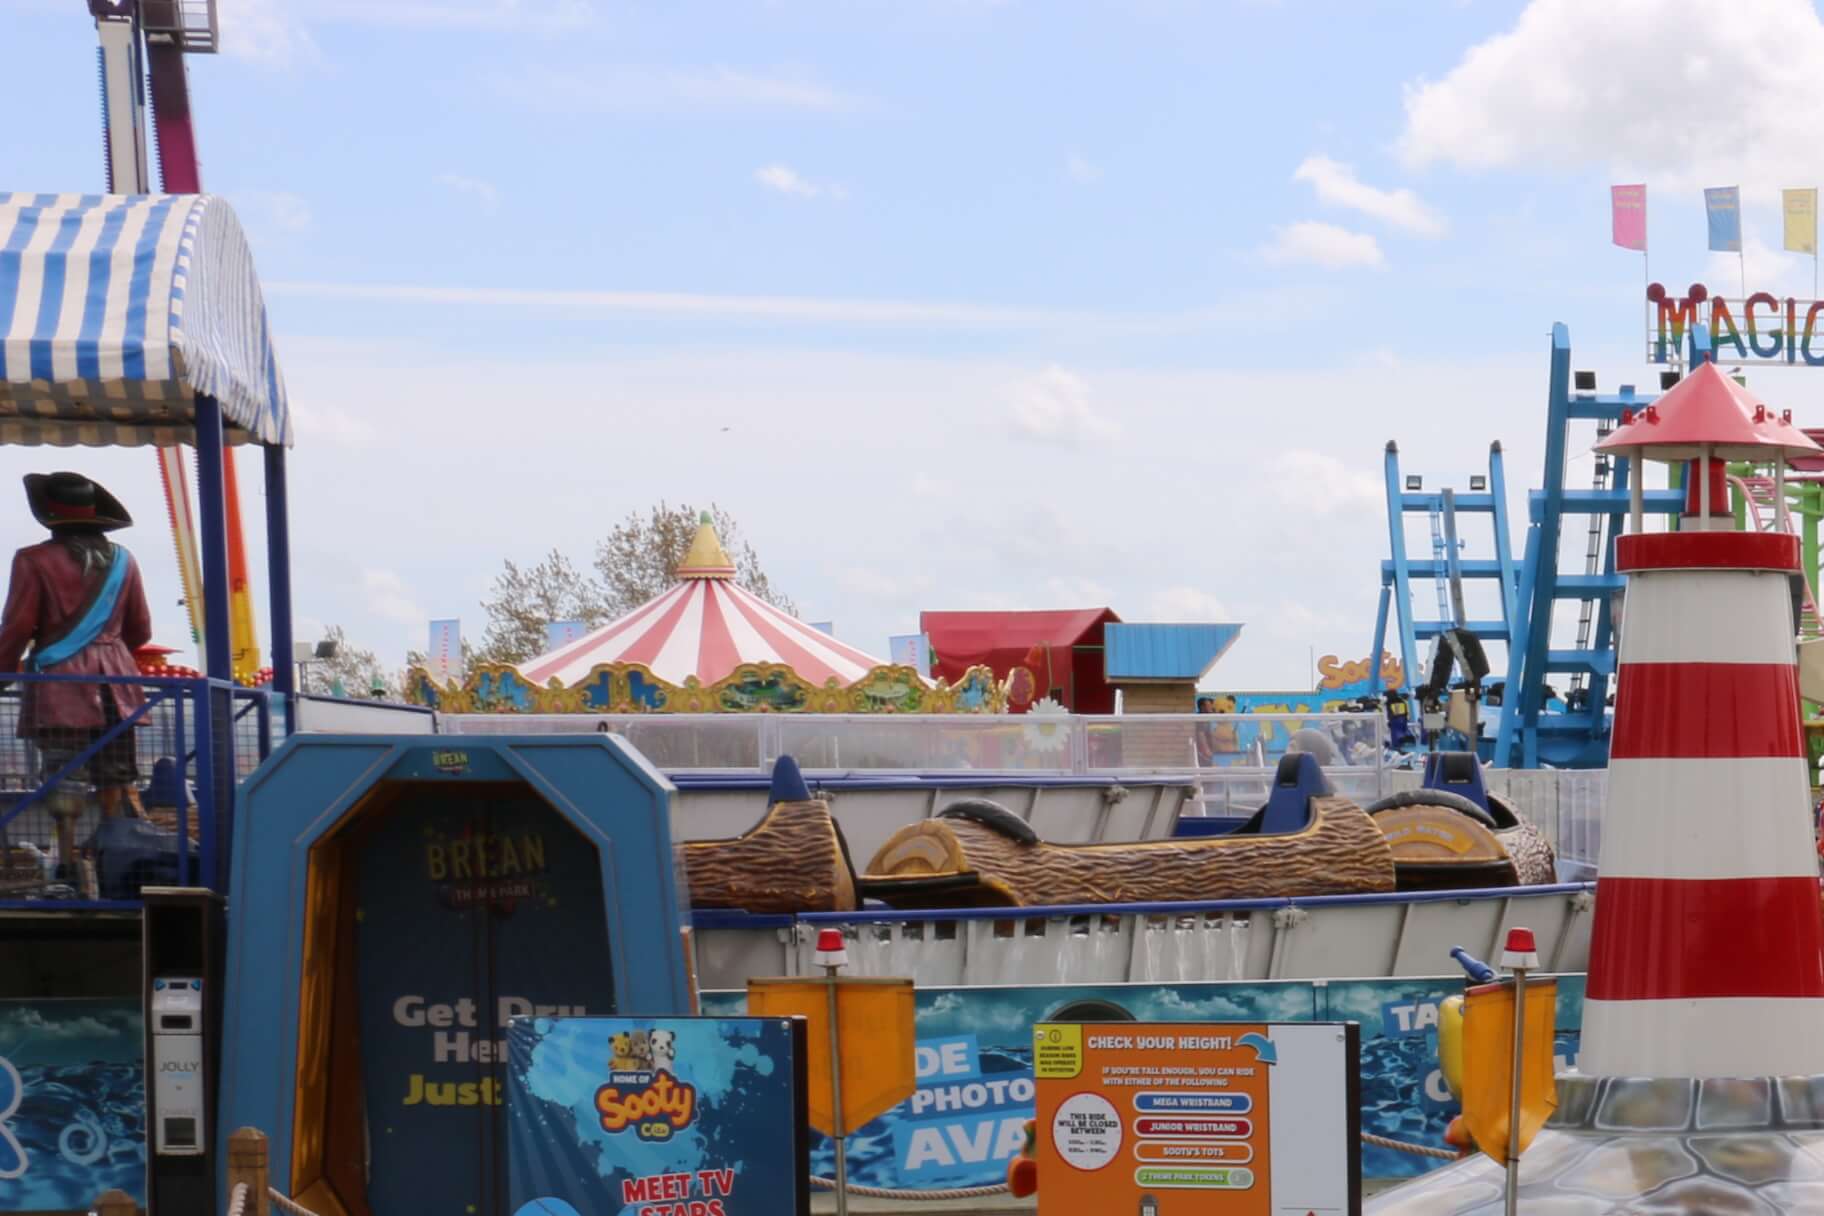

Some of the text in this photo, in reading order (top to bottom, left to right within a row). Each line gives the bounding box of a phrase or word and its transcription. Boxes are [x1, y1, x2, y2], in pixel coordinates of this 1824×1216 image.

[393, 995, 478, 1028] Get
[1087, 1036, 1233, 1051] CHECK YOUR HEIGHT!
[160, 1061, 200, 1073] JOLLY
[1142, 1066, 1161, 1076] TALL
[1199, 1067, 1216, 1077] YOU
[1217, 1068, 1235, 1077] CAN
[1236, 1068, 1255, 1077] RIDE
[1103, 1077, 1229, 1087] WITH EITHER OF THE FOLLOWING
[403, 1074, 502, 1106] Just
[597, 1071, 694, 1130] Sooty
[1152, 1098, 1233, 1108] MEGA WRISTBAND
[1078, 1120, 1087, 1128] BE
[1089, 1120, 1119, 1128] CLOSED
[1150, 1122, 1238, 1132] JUNIOR WRISTBAND
[1202, 1147, 1225, 1157] TOTS
[623, 1168, 735, 1204] MEET TV
